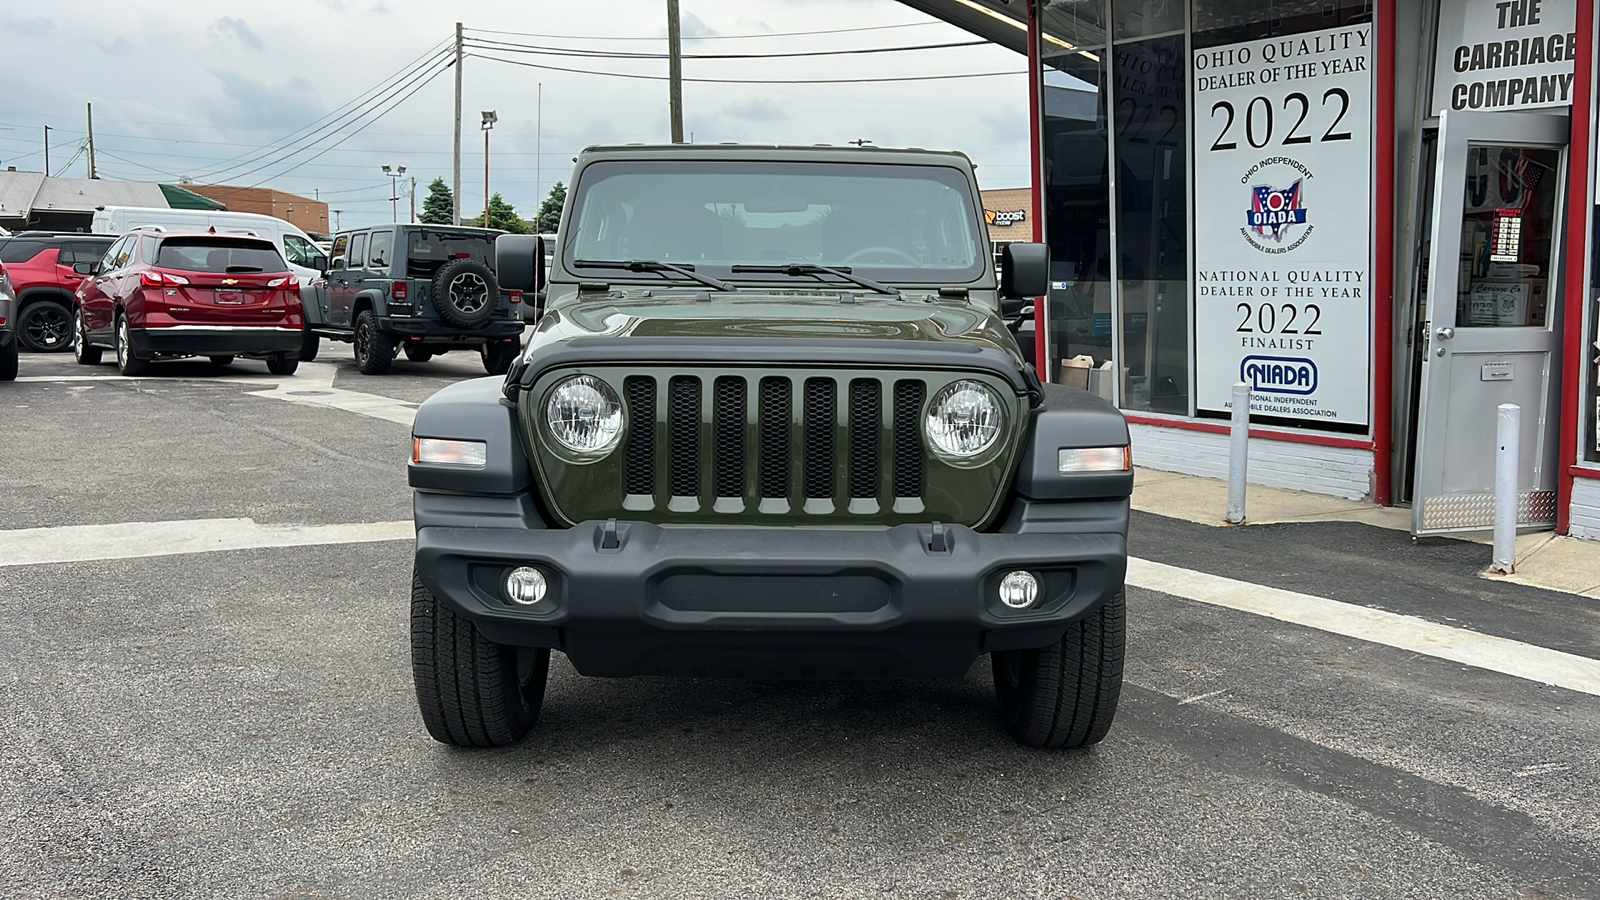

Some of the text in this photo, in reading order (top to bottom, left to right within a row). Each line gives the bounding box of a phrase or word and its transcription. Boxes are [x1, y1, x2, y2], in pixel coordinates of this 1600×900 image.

[1496, 0, 1541, 29] THE
[1196, 29, 1370, 70] OHIO QUALITY
[1454, 33, 1576, 73] CARRIAGE
[1198, 71, 1256, 91] DEALER
[1260, 67, 1280, 84] OF
[1284, 62, 1317, 81] THE
[1321, 56, 1366, 75] YEAR
[1451, 73, 1574, 111] COMPANY
[1210, 87, 1352, 151] 2022
[1241, 156, 1314, 184] OHIO INDEPENDENT
[996, 210, 1024, 220] boost
[1253, 210, 1297, 225] OIADA
[1240, 224, 1314, 254] AUTOMOBILE DEALERS ASSOCIATION
[1199, 270, 1364, 284] NATIONAL QUALITY
[1200, 286, 1362, 299] DEALER OF THE YEAR
[1236, 302, 1322, 335] 2022
[1470, 302, 1493, 312] 022
[1241, 337, 1314, 350] FINALIST
[1246, 363, 1310, 387] NIADA
[1250, 394, 1317, 406] TIONAL INDEPENDENT
[1264, 404, 1291, 414] DEALERS
[1292, 407, 1337, 418] ASSOCIATION
